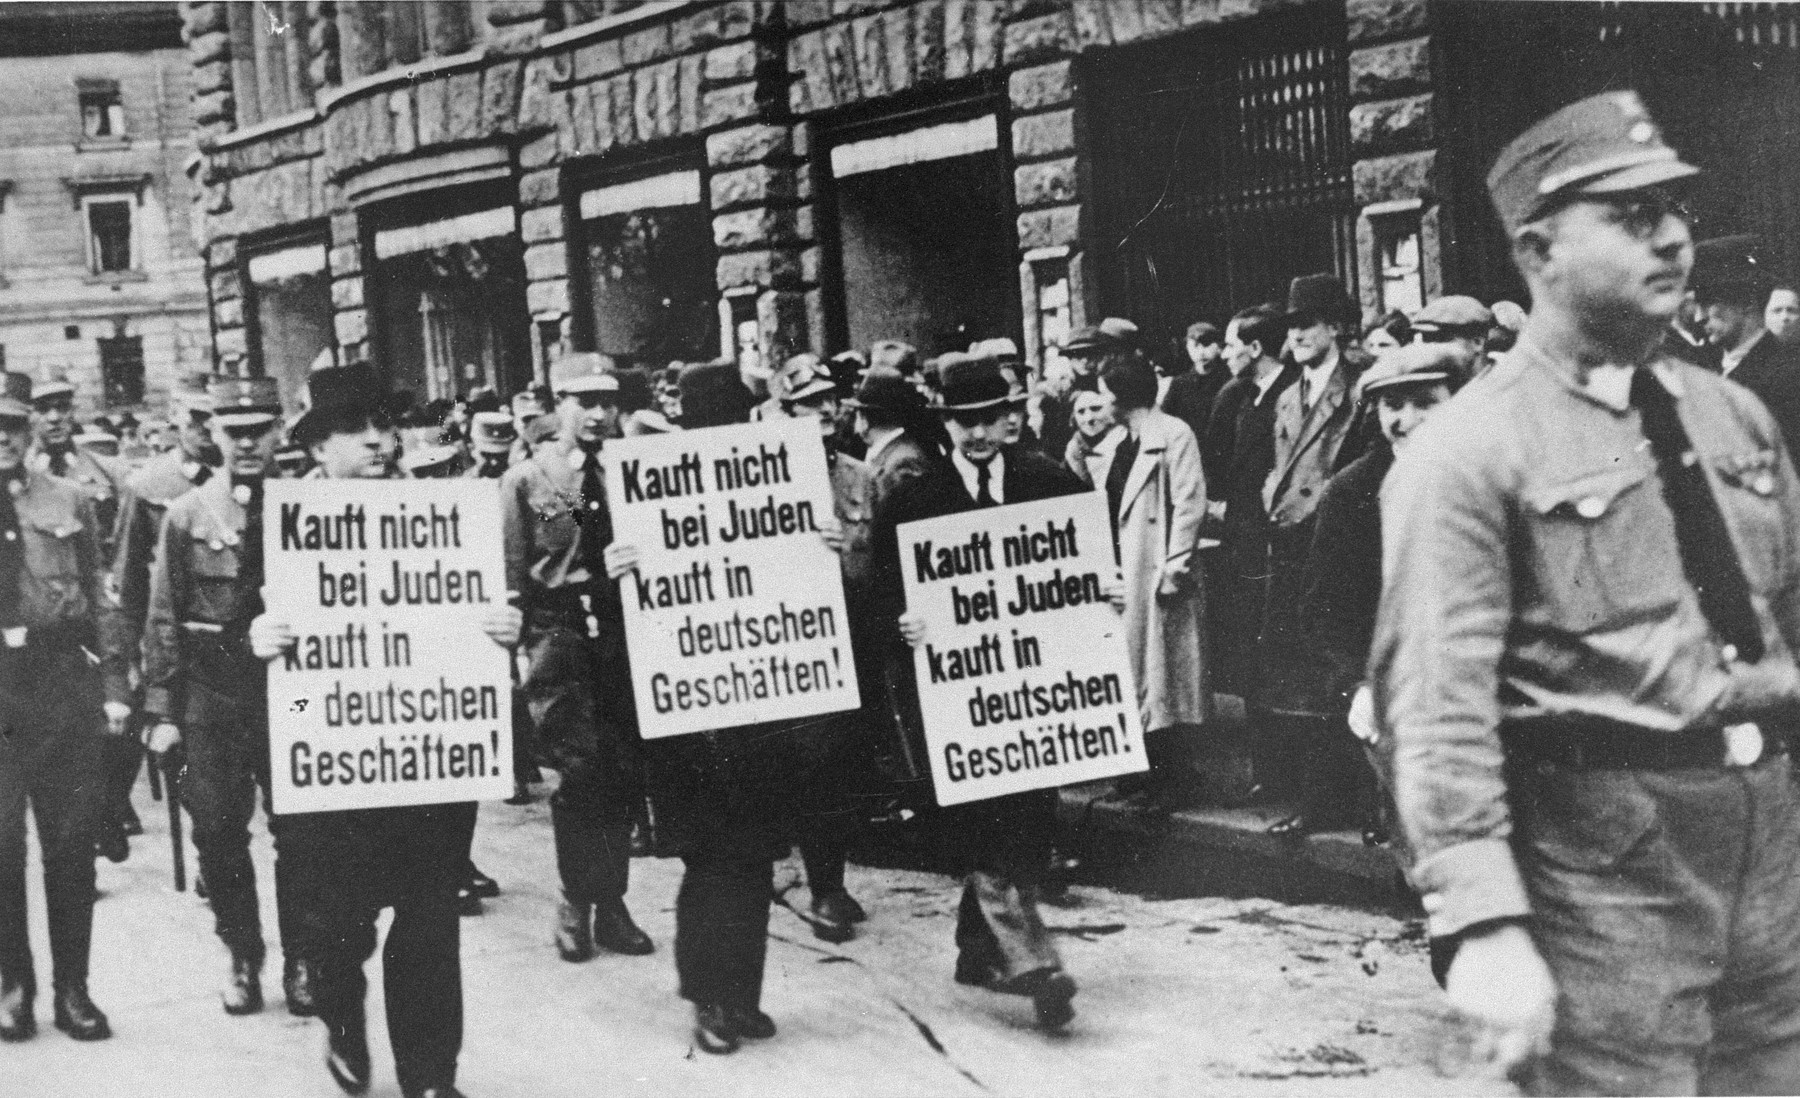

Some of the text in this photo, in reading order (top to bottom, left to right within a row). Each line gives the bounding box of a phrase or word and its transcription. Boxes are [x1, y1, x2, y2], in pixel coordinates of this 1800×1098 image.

[621, 442, 791, 503] Kauft nicht
[281, 503, 461, 550] Kauft nicht
[661, 504, 710, 550] bei
[913, 517, 1079, 583] Kauft nicht
[318, 561, 367, 607] bei
[631, 557, 753, 611] kauft in
[951, 579, 999, 626] bei
[383, 622, 411, 667] in
[677, 602, 836, 657] deutschen
[926, 628, 1042, 683] kauft in
[325, 676, 498, 727] deutschen
[650, 647, 844, 713] Geschäften!
[968, 670, 1123, 727] deutschen
[290, 730, 499, 788] Geschäften!
[944, 712, 1131, 782] Geschäften!
